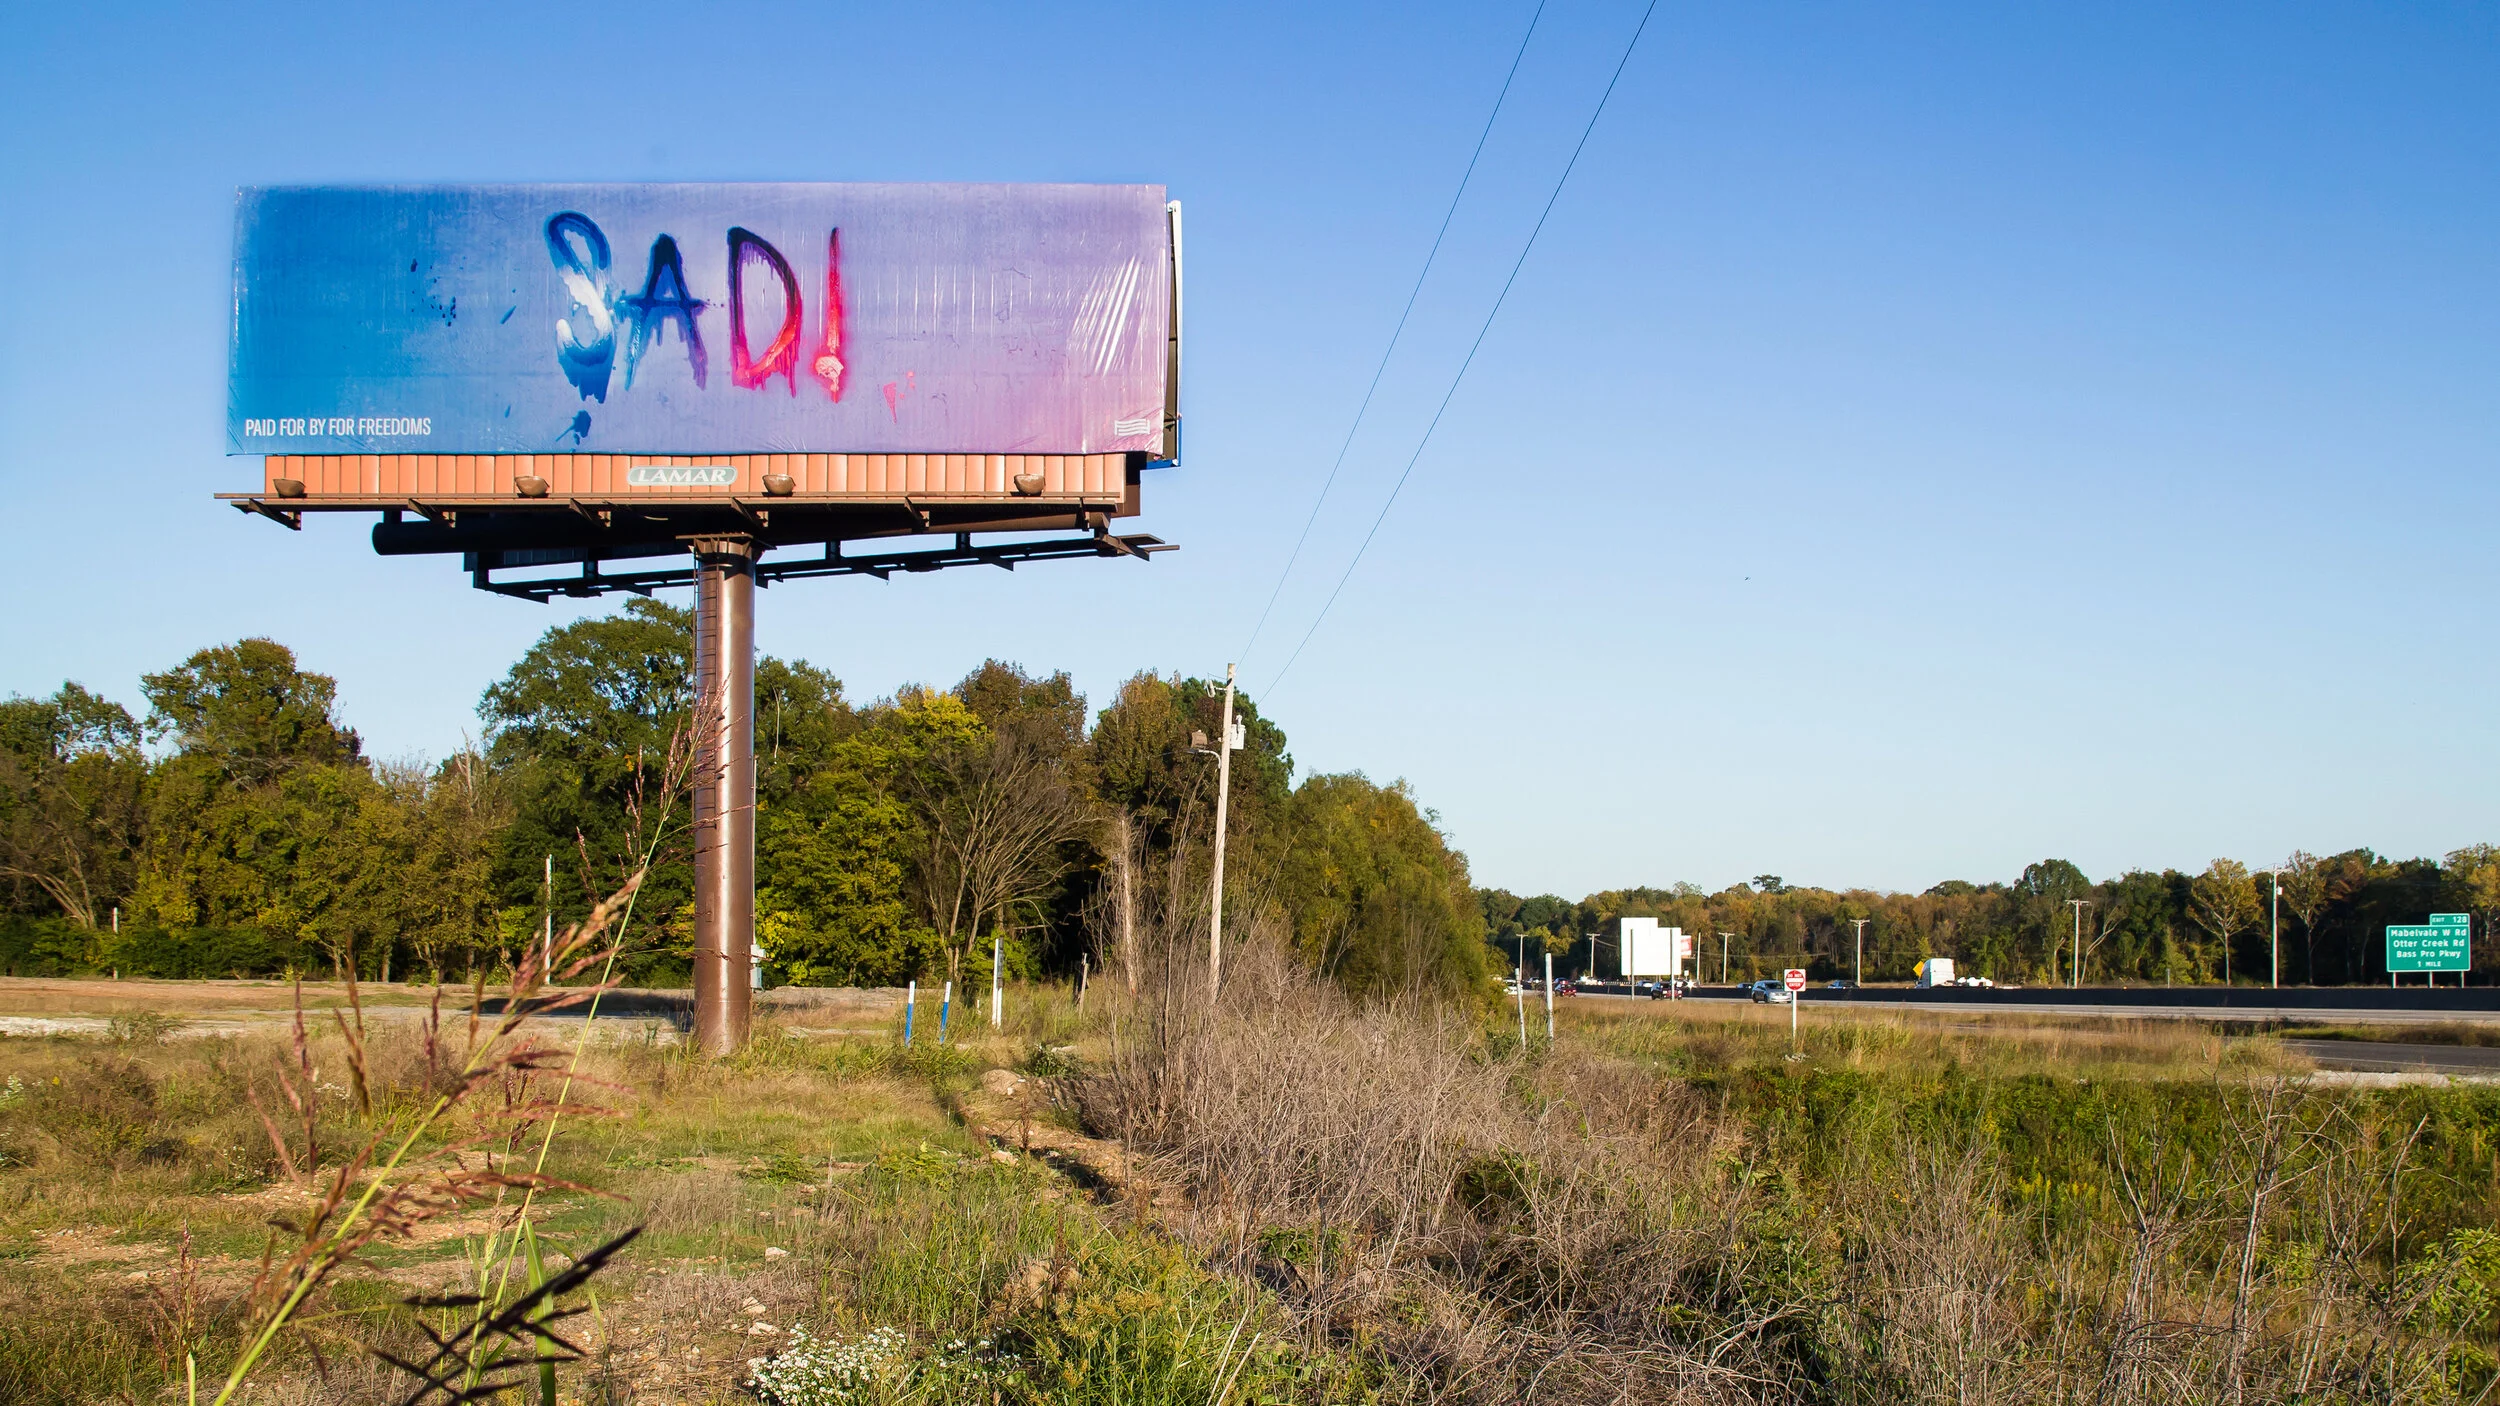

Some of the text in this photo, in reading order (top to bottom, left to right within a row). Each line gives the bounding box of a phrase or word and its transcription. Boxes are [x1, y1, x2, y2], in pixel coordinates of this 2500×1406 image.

[543, 210, 846, 404] SAD!
[245, 417, 432, 437] PAID FOR BY FOR FREEDOMS
[637, 469, 727, 482] LAMAR
[2455, 928, 2467, 936] Rd
[2422, 939, 2449, 947] Creek
[2453, 939, 2465, 947] Rd
[2439, 950, 2461, 958] Pkwy
